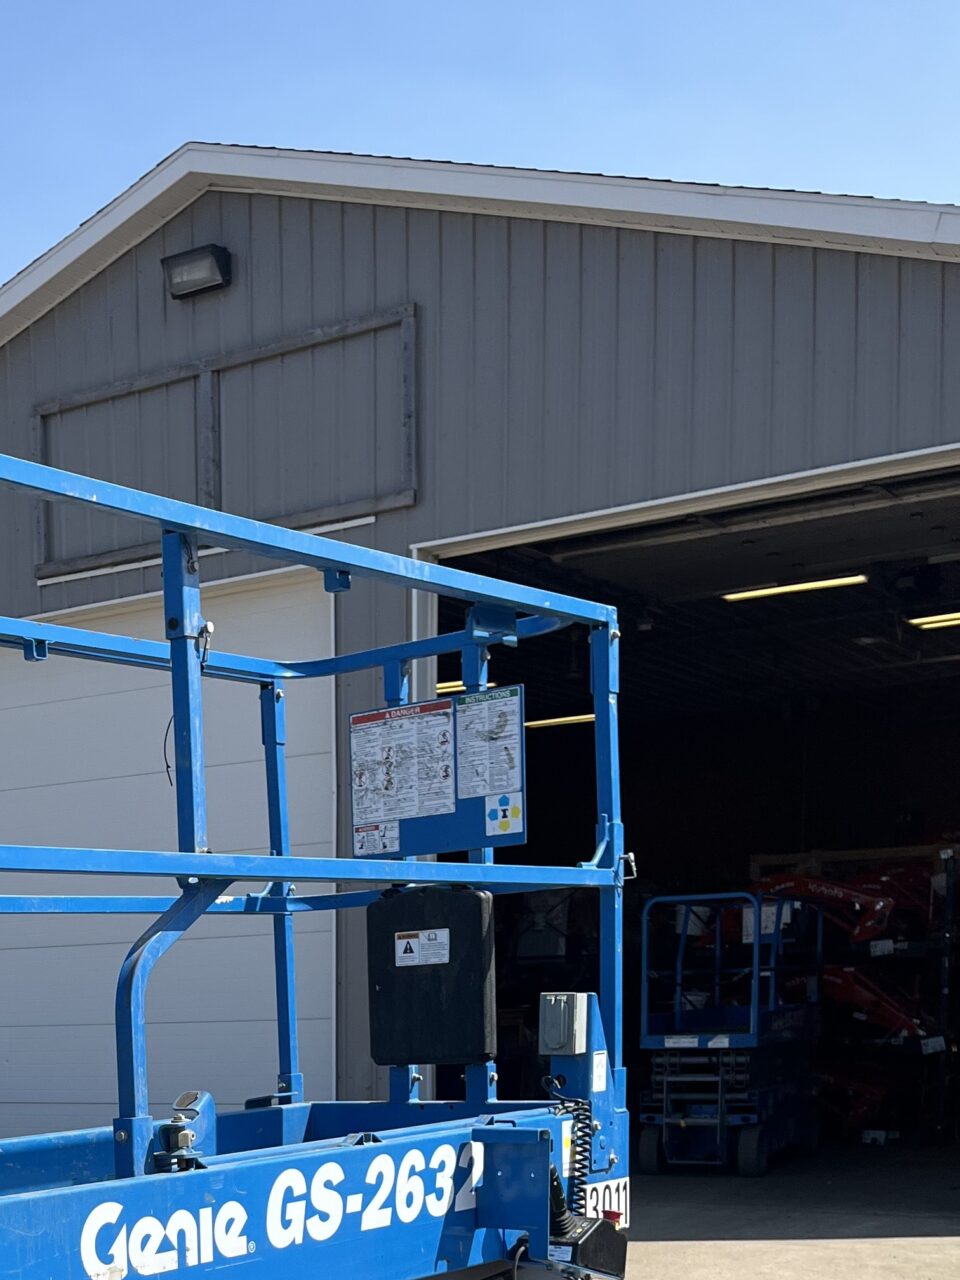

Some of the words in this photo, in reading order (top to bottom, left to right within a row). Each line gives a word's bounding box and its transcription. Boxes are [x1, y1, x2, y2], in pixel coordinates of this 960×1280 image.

[465, 690, 511, 704] INSTRUCTIONS
[391, 707, 421, 718] DANGER
[266, 1140, 485, 1249] GS-2632
